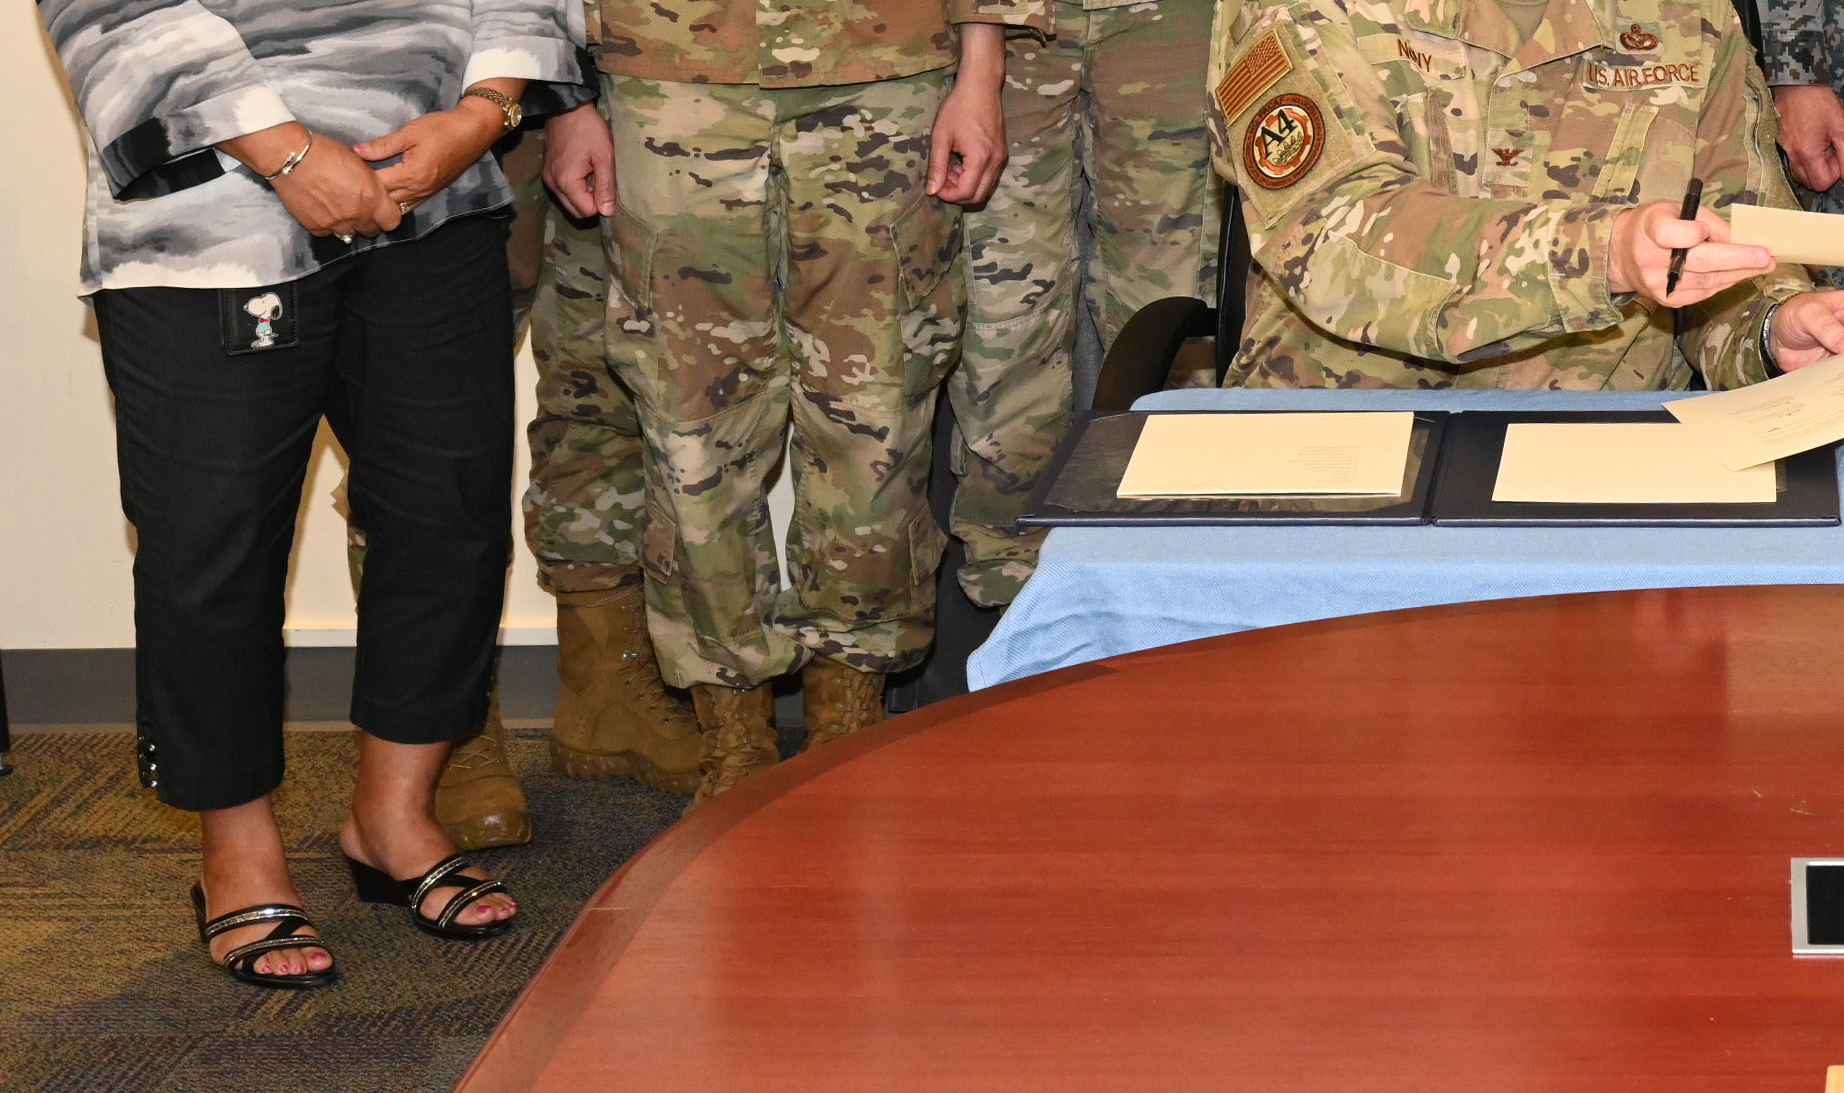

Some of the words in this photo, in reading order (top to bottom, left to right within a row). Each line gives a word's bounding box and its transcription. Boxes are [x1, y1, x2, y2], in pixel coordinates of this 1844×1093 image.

[1588, 63, 1610, 86] U.S.
[1614, 68, 1641, 87] AIR
[1641, 63, 1701, 84] FORCE
[1261, 108, 1298, 160] A4
